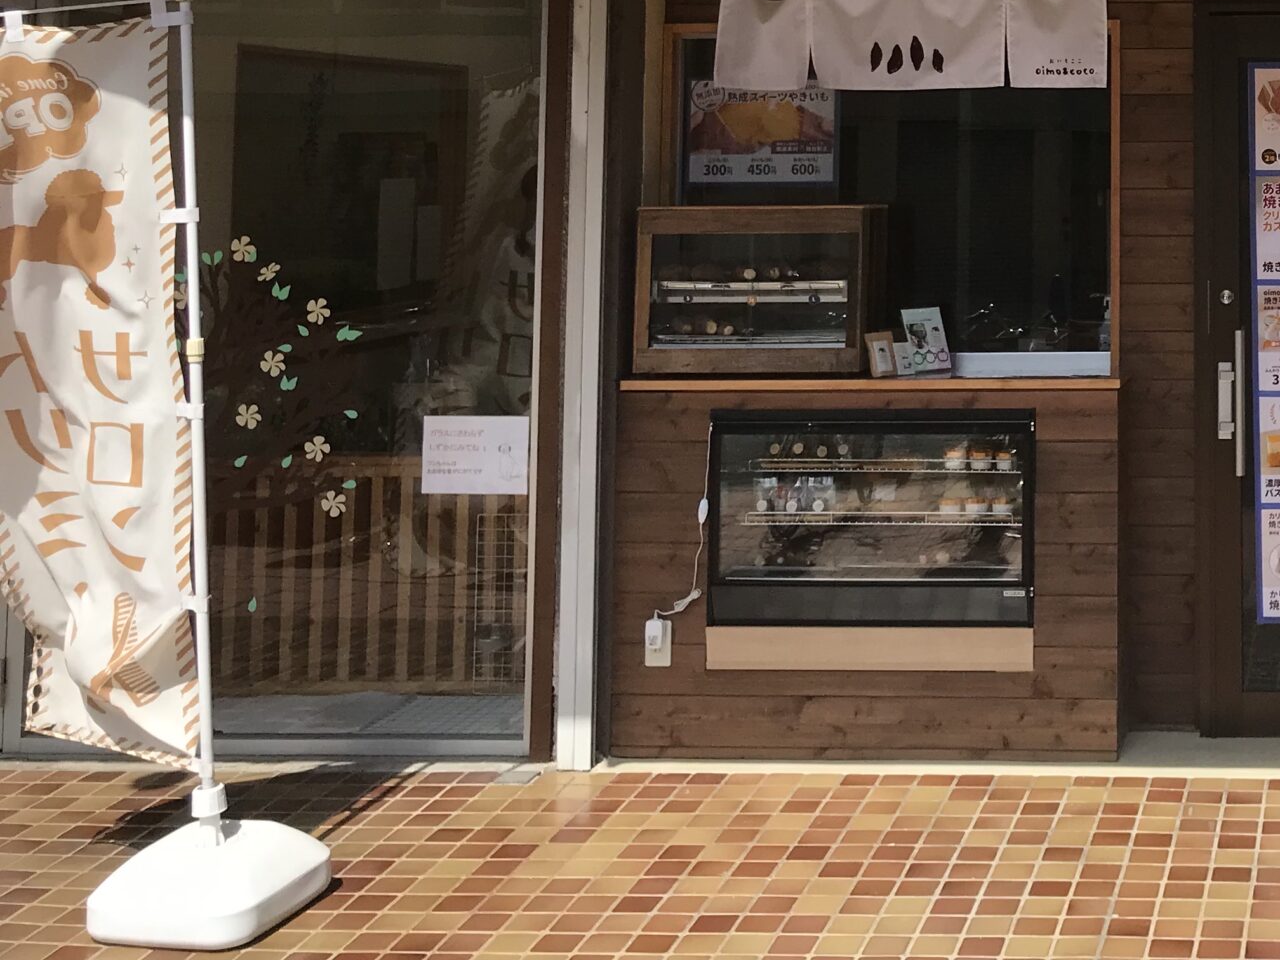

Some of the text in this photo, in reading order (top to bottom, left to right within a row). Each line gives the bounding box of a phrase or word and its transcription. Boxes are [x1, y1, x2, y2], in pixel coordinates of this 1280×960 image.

[727, 91, 830, 103] 熟成スイーツやきいも
